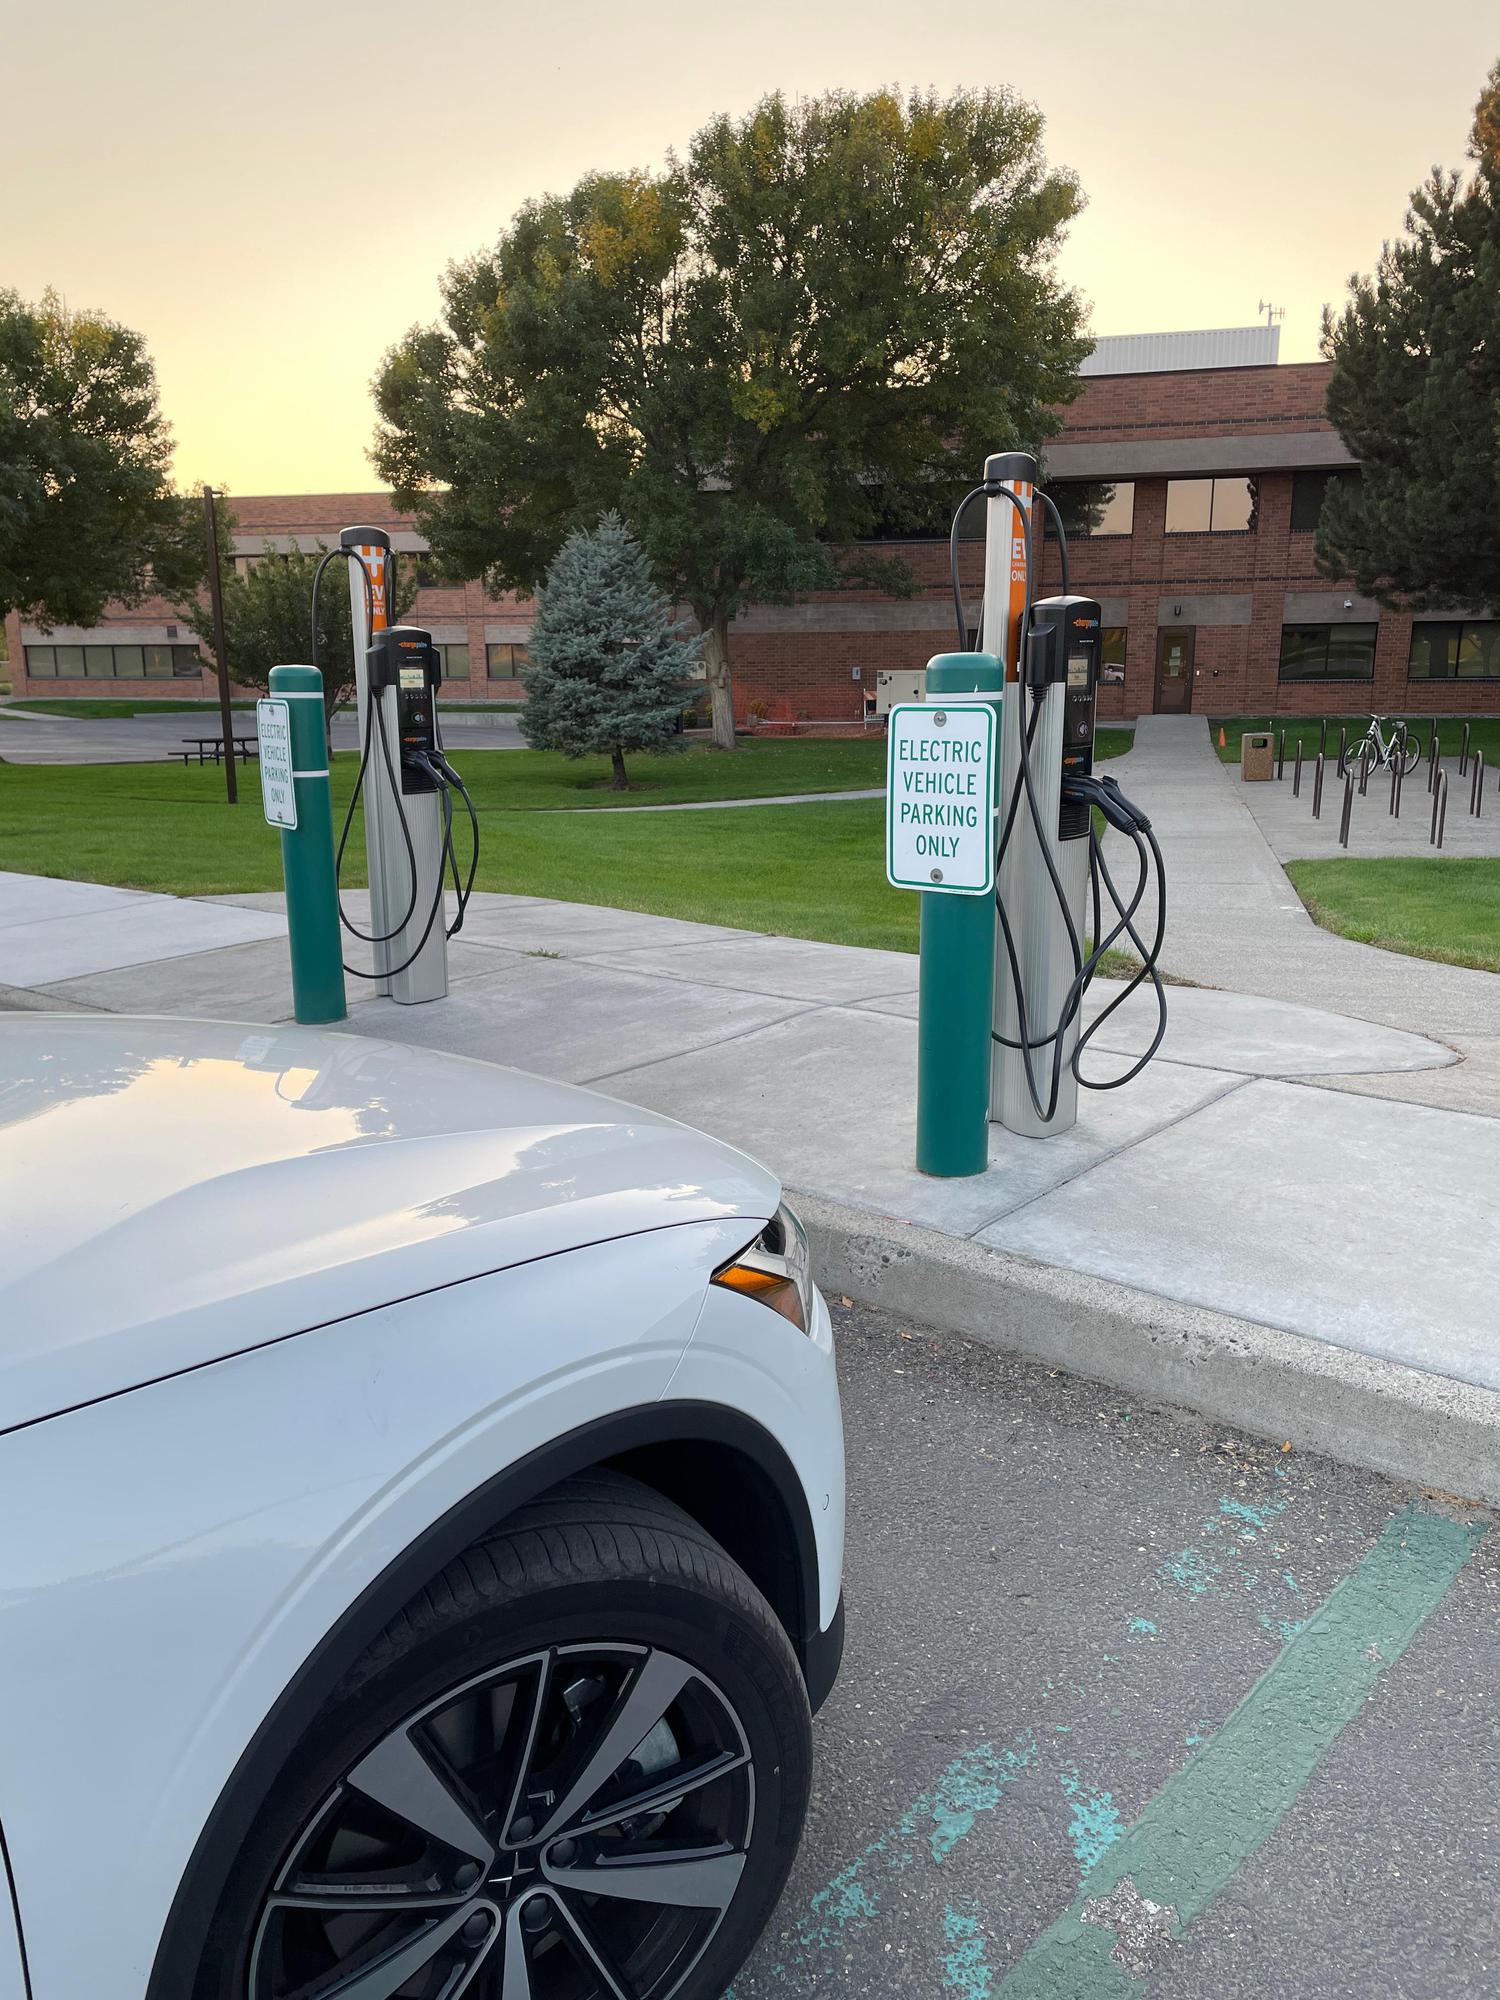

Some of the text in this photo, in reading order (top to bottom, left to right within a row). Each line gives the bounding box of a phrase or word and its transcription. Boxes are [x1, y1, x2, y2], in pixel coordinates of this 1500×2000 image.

[1011, 570, 1027, 581] ONL
[261, 723, 287, 740] ELECTRIC
[263, 745, 287, 762] VEHICLE
[899, 739, 982, 763] ELECTRIC
[264, 766, 289, 783] PARKING
[903, 771, 977, 796] VEHICLE
[271, 788, 285, 804] ONLY
[900, 802, 977, 828] PARKING
[915, 834, 960, 858] ONLY
